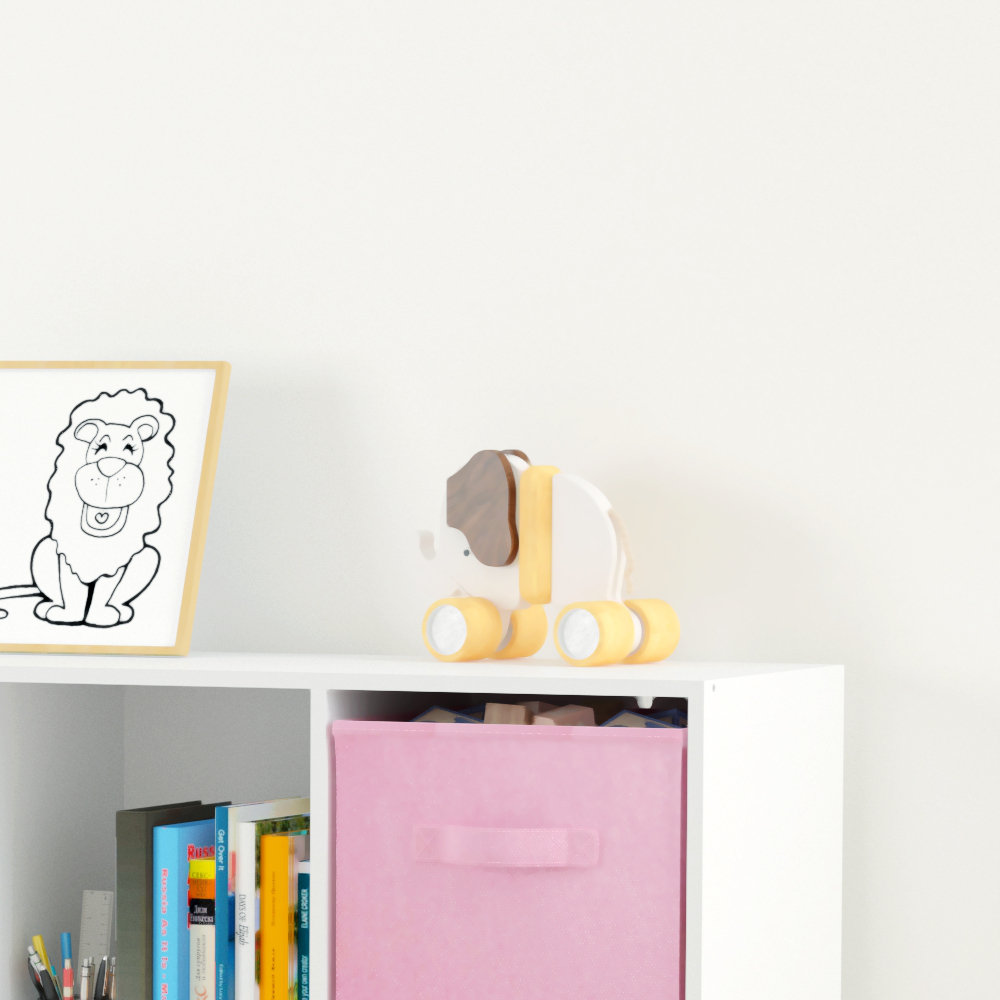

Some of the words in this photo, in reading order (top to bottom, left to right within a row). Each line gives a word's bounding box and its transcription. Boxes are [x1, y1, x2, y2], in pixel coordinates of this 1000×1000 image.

[217, 829, 225, 845] Get
[187, 844, 215, 860] Russ
[217, 846, 225, 864] Over
[161, 868, 169, 914] Russia
[239, 894, 247, 911] DAYS
[239, 912, 247, 922] OF
[161, 919, 169, 936] As
[236, 924, 248, 946] Elijah
[161, 941, 169, 952] It
[301, 985, 309, 997] your
